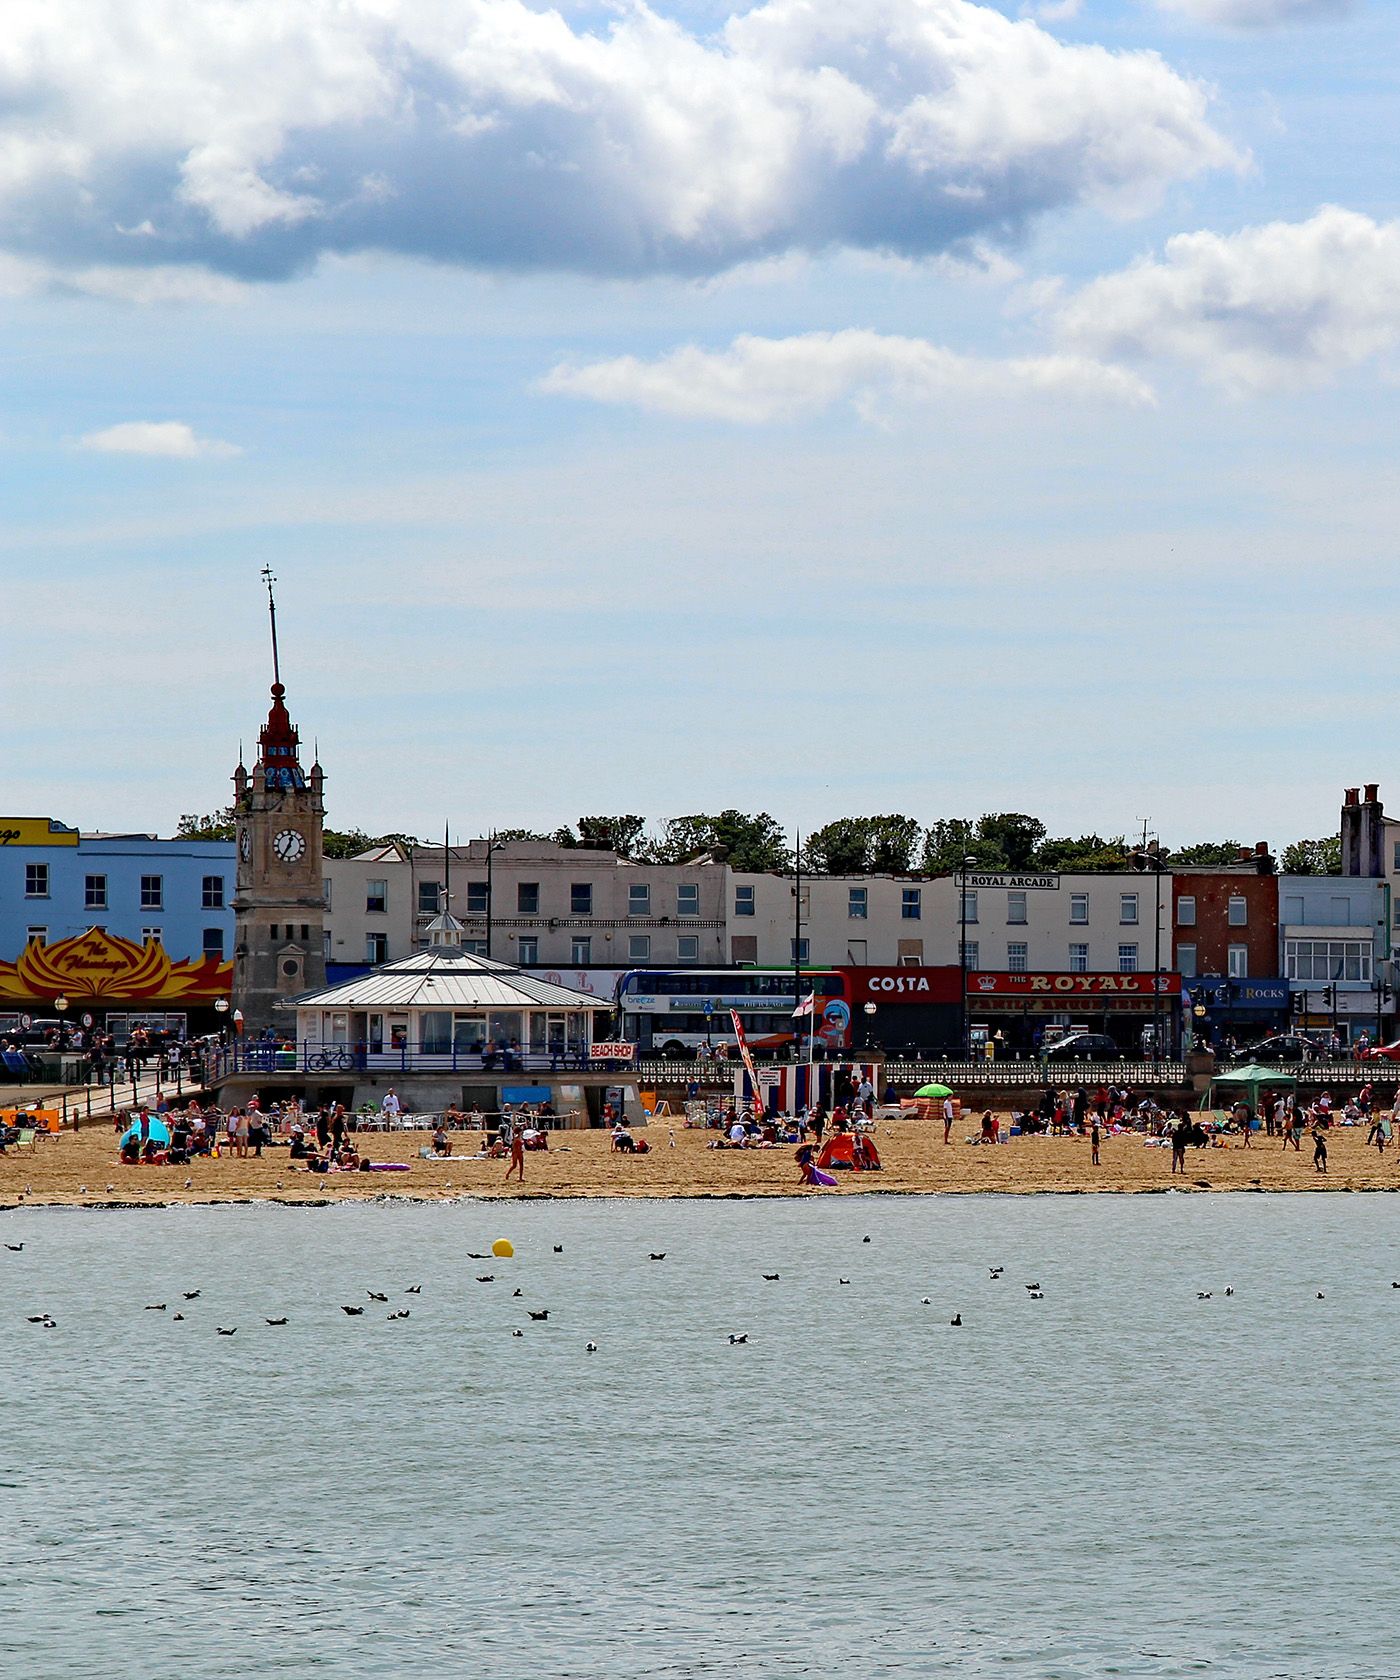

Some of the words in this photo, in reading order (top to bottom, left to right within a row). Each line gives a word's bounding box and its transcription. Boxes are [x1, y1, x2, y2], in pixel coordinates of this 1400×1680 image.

[971, 875, 1006, 886] ROYAL
[1010, 877, 1054, 888] ARCADE
[64, 955, 129, 975] Flamingo
[868, 977, 930, 993] COSTA
[1008, 975, 1027, 983] THE
[1030, 976, 1139, 991] ROYAL
[1246, 987, 1285, 998] ROCKS
[591, 1044, 612, 1057] BEACH
[613, 1044, 632, 1057] SHOP
